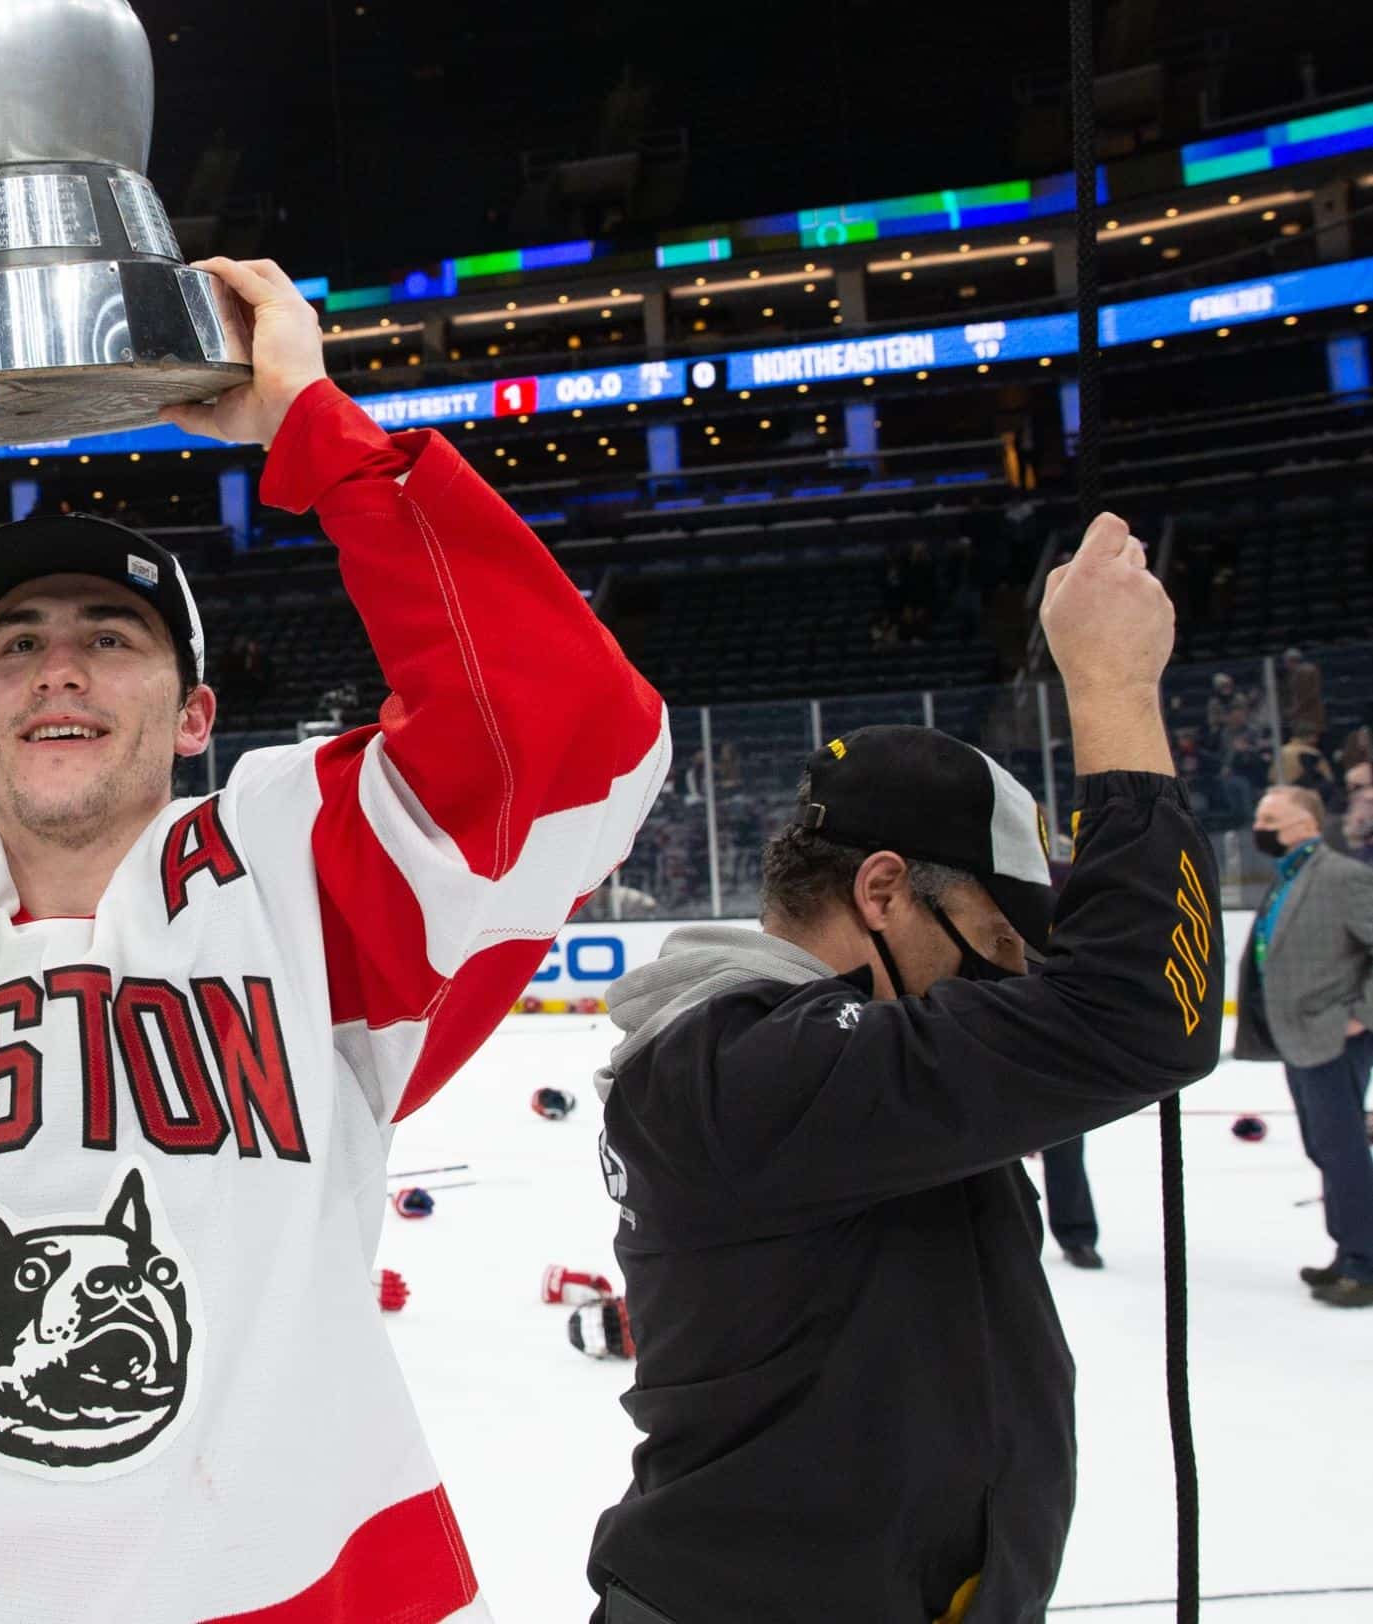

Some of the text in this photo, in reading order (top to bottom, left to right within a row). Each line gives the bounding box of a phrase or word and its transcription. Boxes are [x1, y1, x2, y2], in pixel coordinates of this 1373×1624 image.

[752, 333, 935, 384] NORTHEASTERN
[556, 372, 622, 403] 00.0
[692, 361, 716, 389] 0
[503, 384, 521, 410] 1
[161, 795, 247, 924] A
